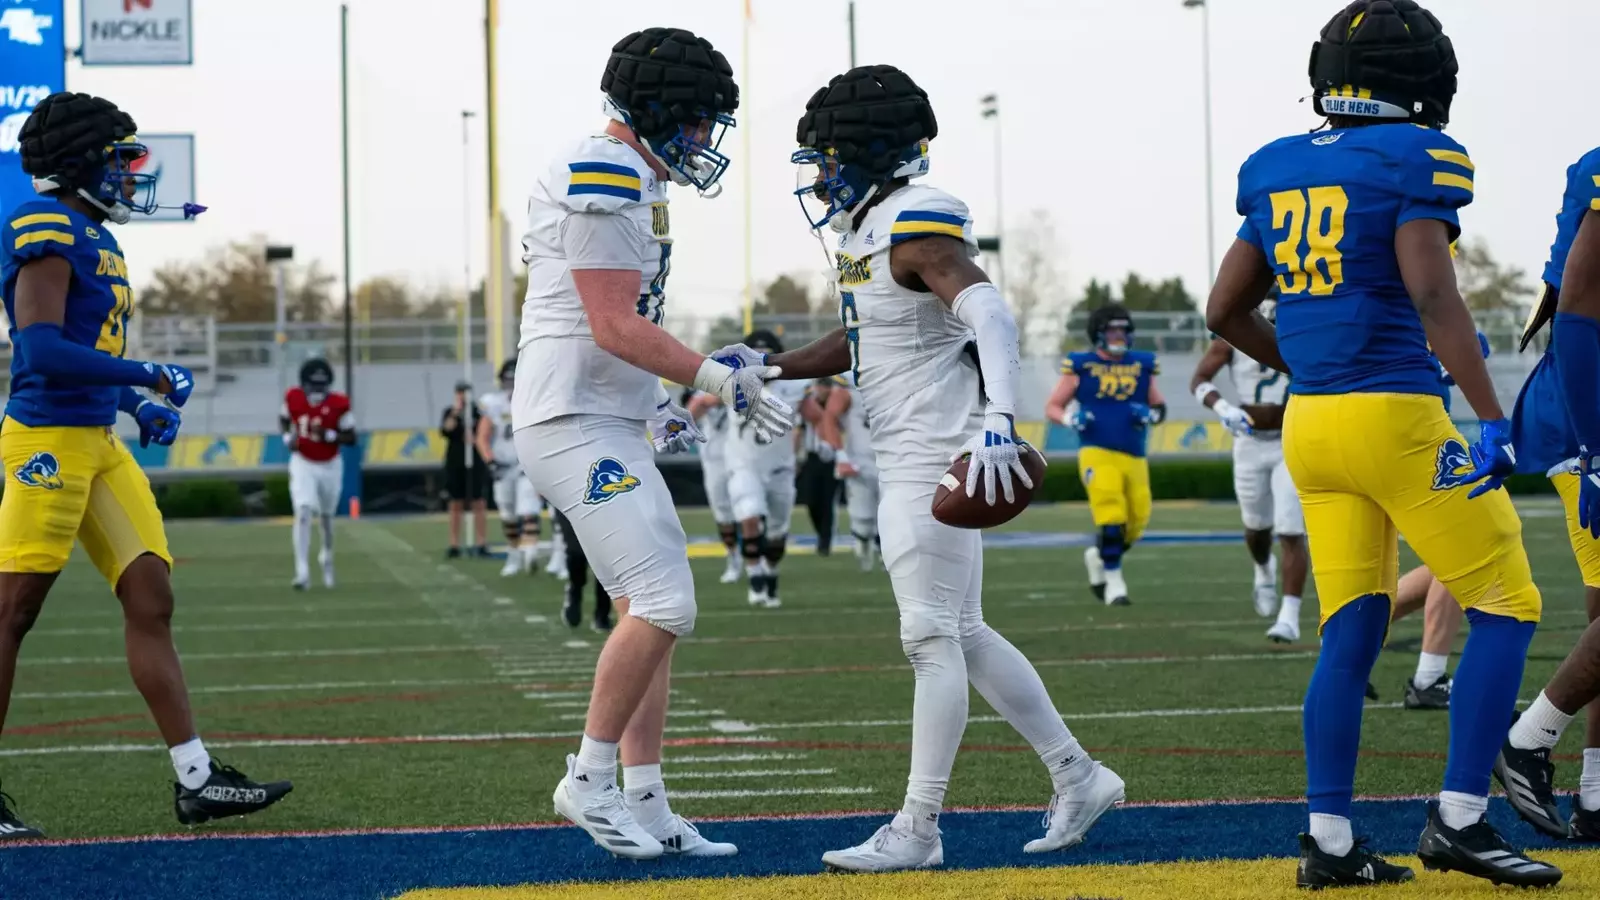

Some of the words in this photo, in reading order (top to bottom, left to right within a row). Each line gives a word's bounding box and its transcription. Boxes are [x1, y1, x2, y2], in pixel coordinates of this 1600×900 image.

[91, 19, 182, 41] NICKLE
[1326, 99, 1346, 112] BLUE
[1348, 101, 1380, 115] HENS
[1269, 185, 1349, 296] 38
